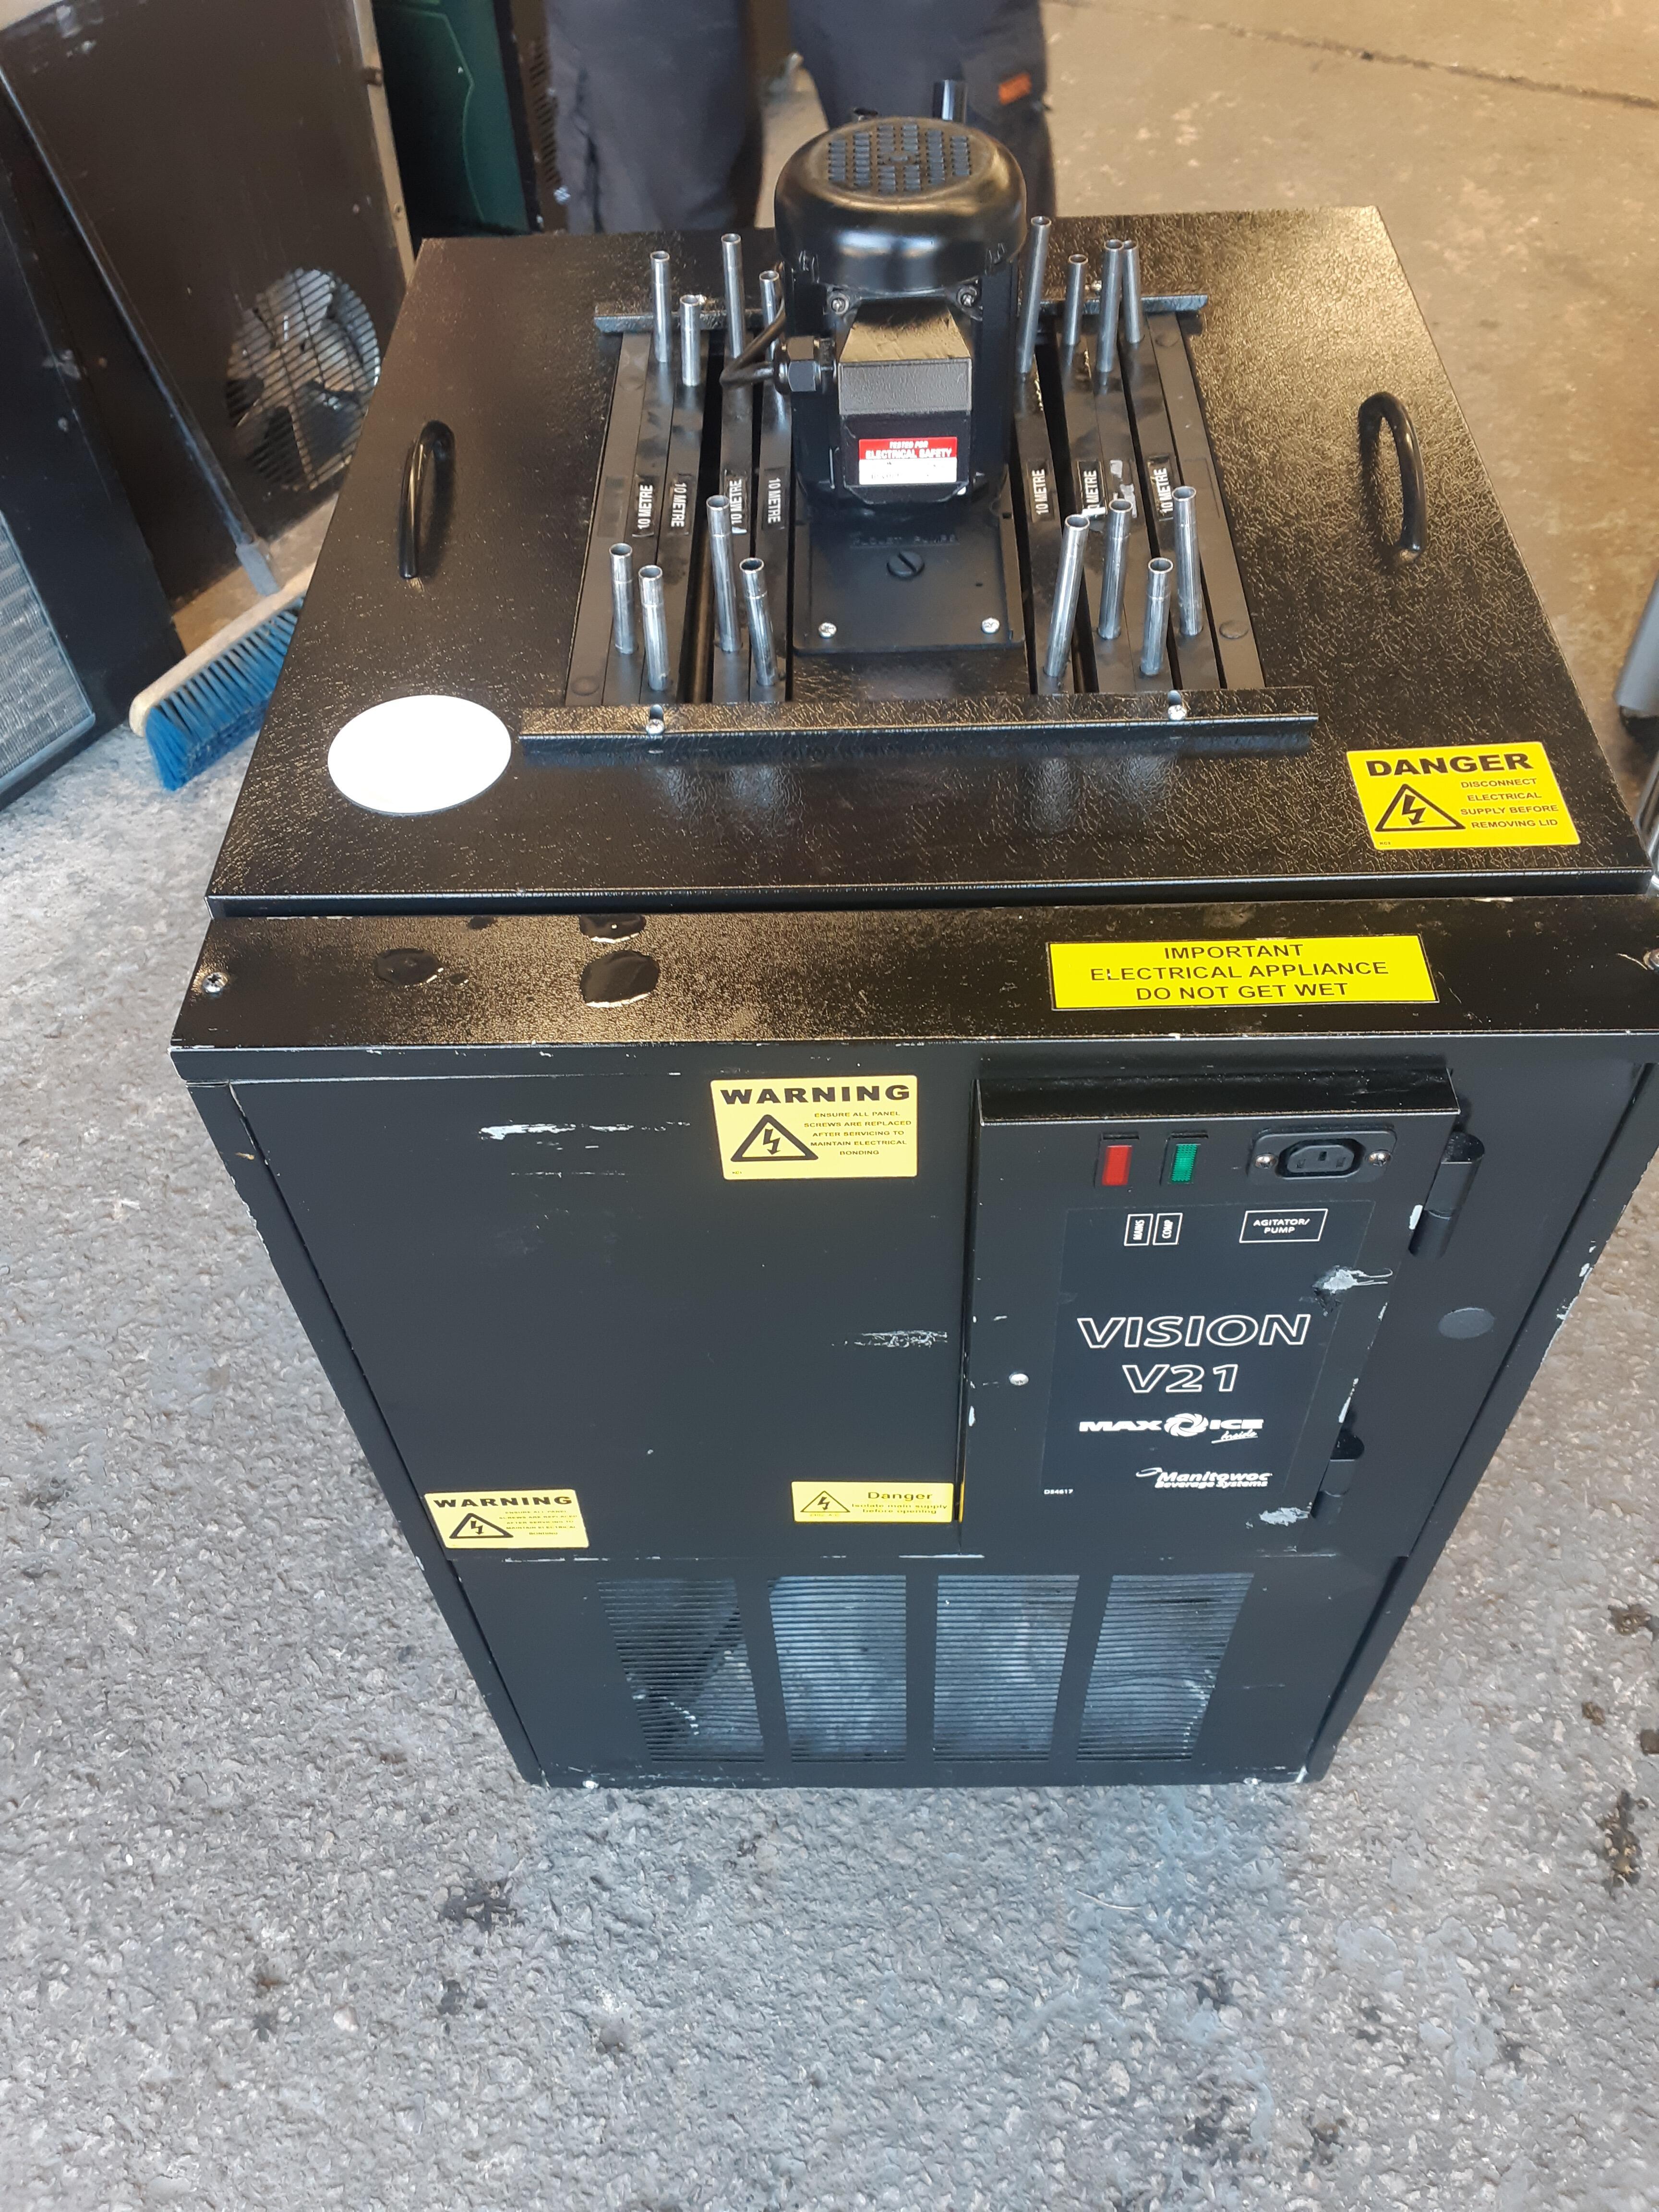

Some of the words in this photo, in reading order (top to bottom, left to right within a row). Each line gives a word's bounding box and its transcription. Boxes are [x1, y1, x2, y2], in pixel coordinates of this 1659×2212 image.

[866, 449, 917, 459] ELECTRICAL
[919, 448, 952, 458] SAFETY
[674, 482, 687, 493] 10
[768, 477, 781, 489] 10
[1032, 469, 1047, 503] METRE
[1083, 470, 1100, 503] METRE
[1154, 468, 1172, 501] METRE
[638, 484, 653, 517] METRE
[729, 479, 743, 513] METRE
[671, 494, 686, 528] METRE
[768, 490, 781, 524] METRE
[1035, 503, 1049, 515] 10
[1161, 502, 1174, 514] 10
[637, 518, 651, 529] 10
[731, 513, 743, 525] 10
[1365, 752, 1534, 777] DANGER
[1460, 778, 1538, 788] DISCONNECT
[1467, 792, 1542, 802] ELECTRICAL
[1460, 806, 1506, 815] SUPPLY
[1509, 805, 1559, 814] BEFORE
[1471, 819, 1536, 829] REMOVING
[1164, 944, 1304, 960] IMPORTANT
[1090, 965, 1242, 981] ELECTRICAL
[1249, 961, 1389, 978] APPLIANCE
[1136, 986, 1171, 1001] DO
[1179, 985, 1230, 1000] NOT
[1238, 984, 1286, 999] GET
[1294, 983, 1348, 997] WET
[720, 1084, 910, 1105] WARNING
[1253, 1218, 1310, 1226] AGITATOR/
[1132, 1219, 1145, 1240] MAINS
[1161, 1219, 1174, 1239] COMP
[1077, 1314, 1311, 1348] VISION
[1122, 1364, 1238, 1393] V21
[1079, 1420, 1164, 1431] MAX
[1209, 1419, 1264, 1430] ICE
[1157, 1470, 1271, 1483] Manitowoc
[1154, 1479, 1214, 1489] Beverage
[1215, 1479, 1268, 1488] Systems
[433, 1496, 573, 1508] WARNING
[867, 1491, 933, 1501] Danger
